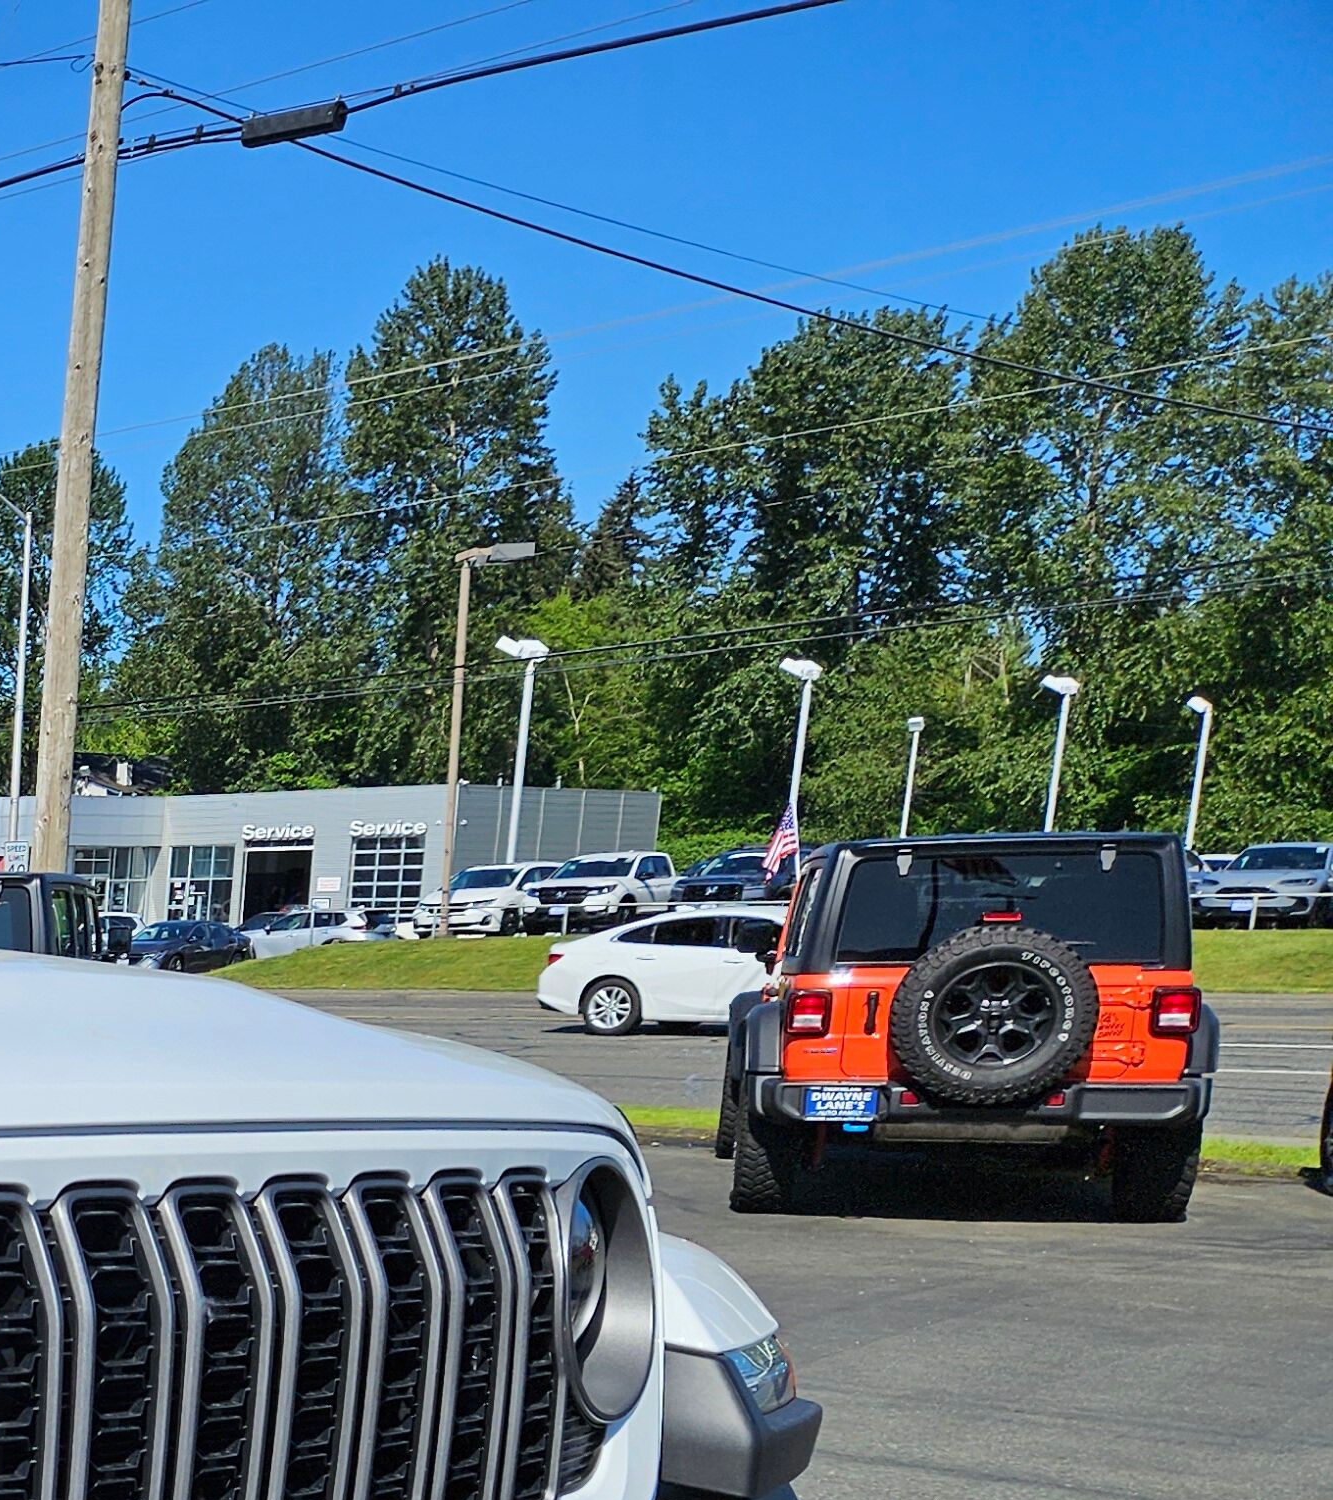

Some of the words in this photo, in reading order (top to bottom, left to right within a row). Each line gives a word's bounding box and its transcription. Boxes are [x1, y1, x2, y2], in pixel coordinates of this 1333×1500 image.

[241, 823, 315, 841] Service
[349, 818, 427, 837] Service
[811, 1092, 873, 1102] DWAYNE
[815, 1101, 865, 1111] LANE'S
